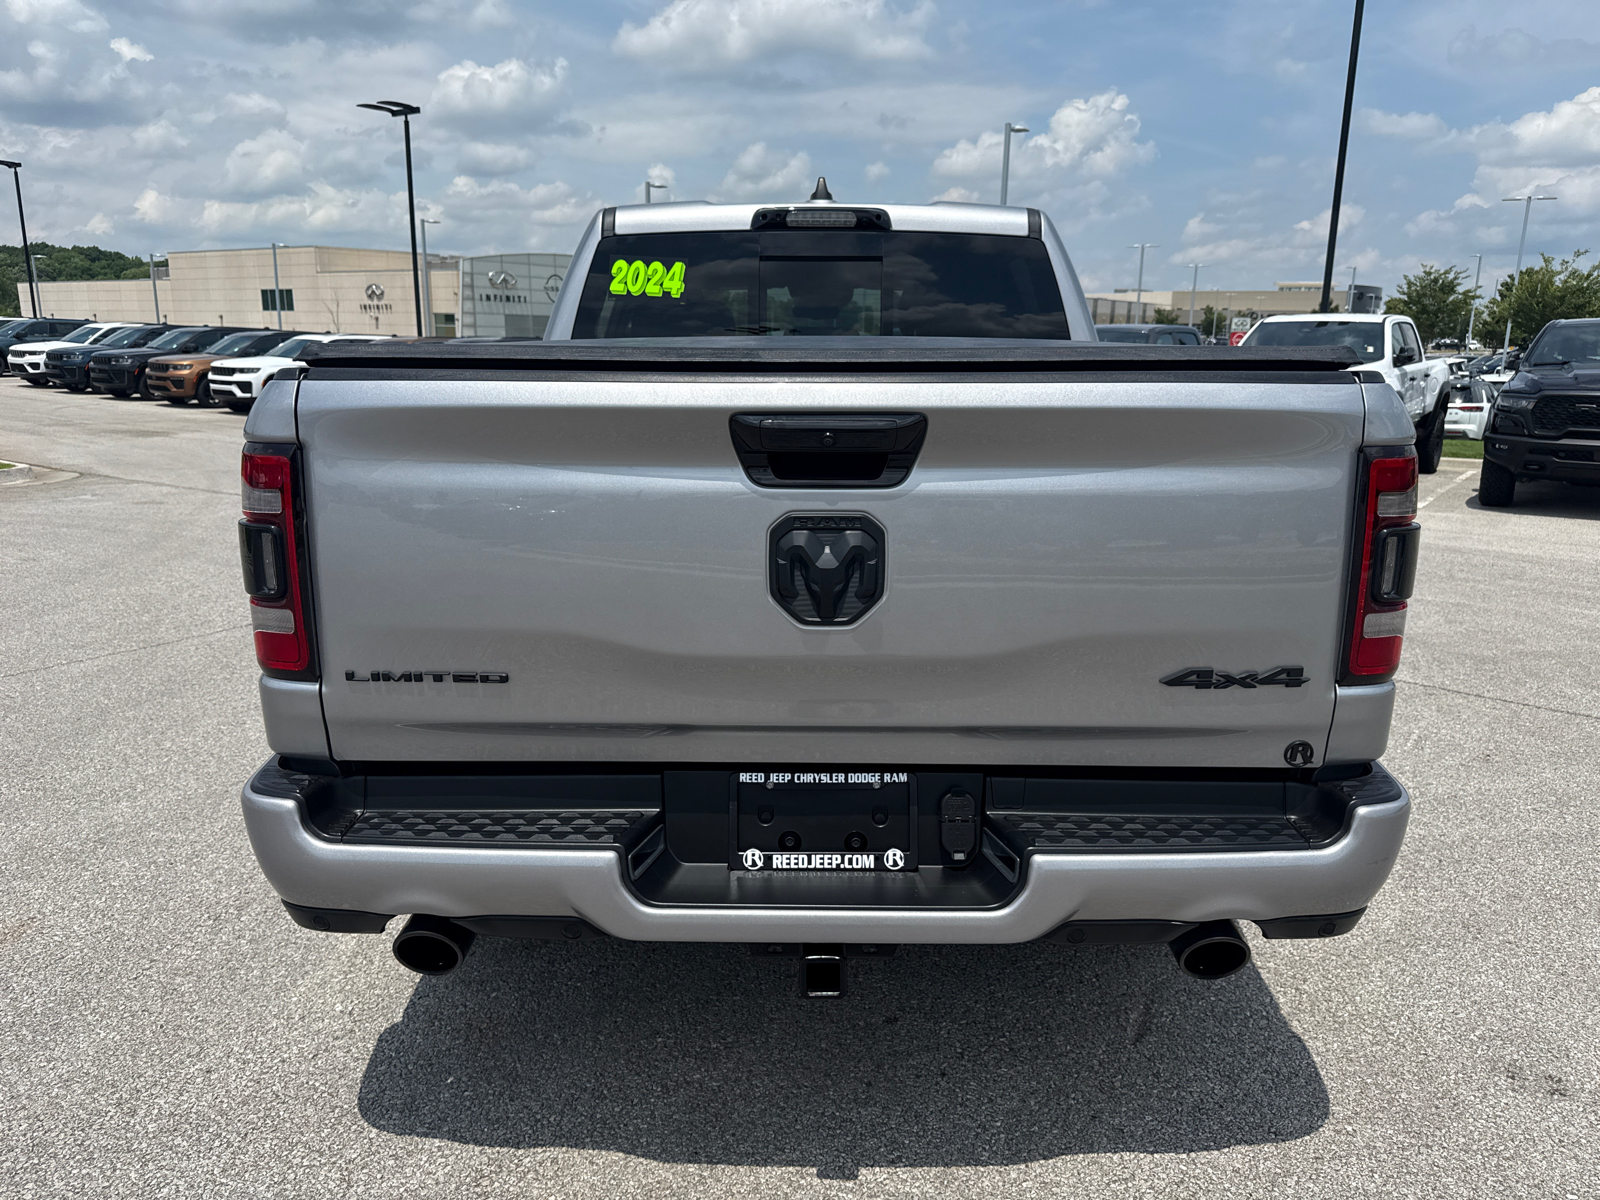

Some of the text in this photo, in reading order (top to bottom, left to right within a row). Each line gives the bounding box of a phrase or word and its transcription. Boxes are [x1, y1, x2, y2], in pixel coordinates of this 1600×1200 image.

[609, 259, 686, 299] 2024
[479, 293, 527, 304] INFINITI
[793, 517, 862, 527] RAM
[345, 670, 509, 684] LIMITED
[739, 772, 908, 783] REED JEEP CHRYSLER DODGE RAM
[772, 854, 875, 869] REEDJEEP.COM
